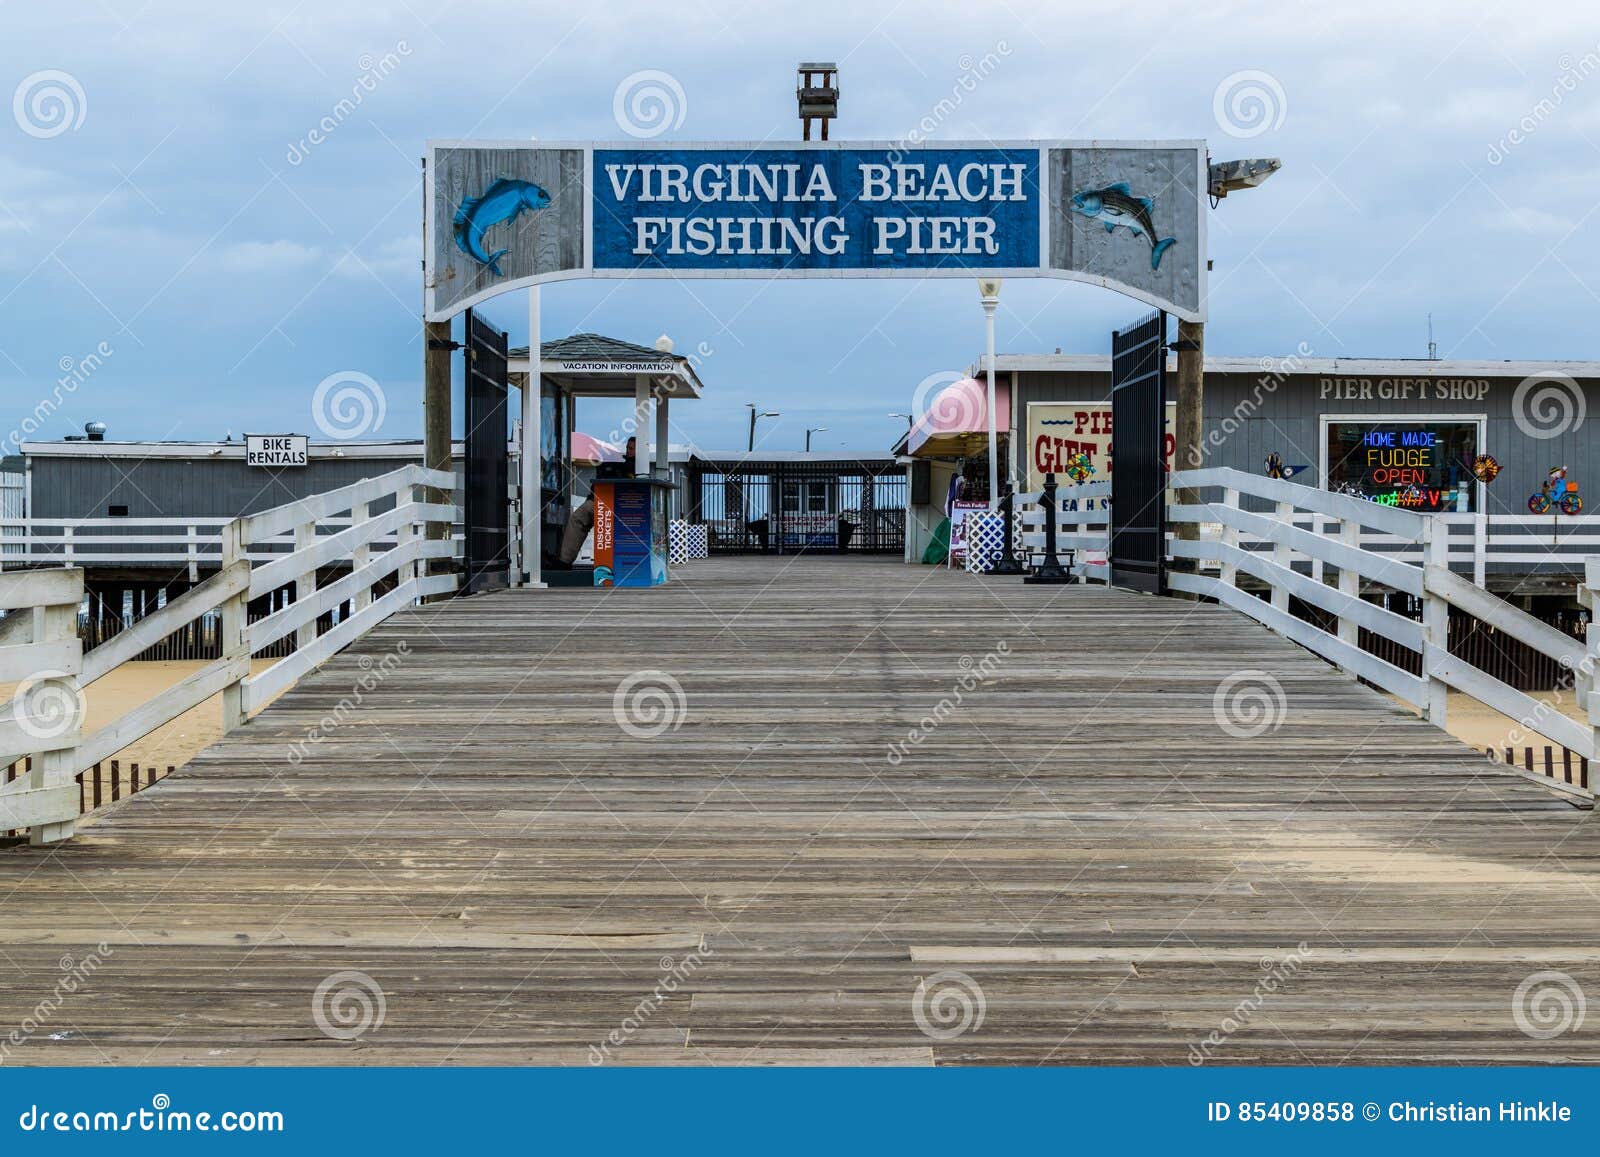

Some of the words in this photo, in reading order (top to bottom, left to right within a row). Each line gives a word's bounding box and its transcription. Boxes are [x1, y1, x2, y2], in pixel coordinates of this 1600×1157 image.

[605, 163, 837, 203] VIRGINIA
[858, 163, 1028, 203] BEACH
[632, 216, 850, 256] FISHING
[873, 216, 1001, 256] PIER
[563, 363, 608, 371] VACATION
[610, 363, 674, 371] INFORMATION
[1319, 379, 1372, 400] PIER
[1377, 379, 1431, 400] GIFT
[1435, 379, 1490, 400] SHOP
[1074, 411, 1113, 434] PIE
[263, 439, 291, 450] BIKE
[1364, 432, 1396, 447] HOME
[1402, 432, 1436, 447] MADE
[249, 452, 305, 463] RENTALS
[1367, 448, 1431, 467] FUDGE
[1373, 468, 1425, 484] OPEN
[597, 500, 605, 550] DISCOUNT
[604, 510, 612, 550] TICKETS
